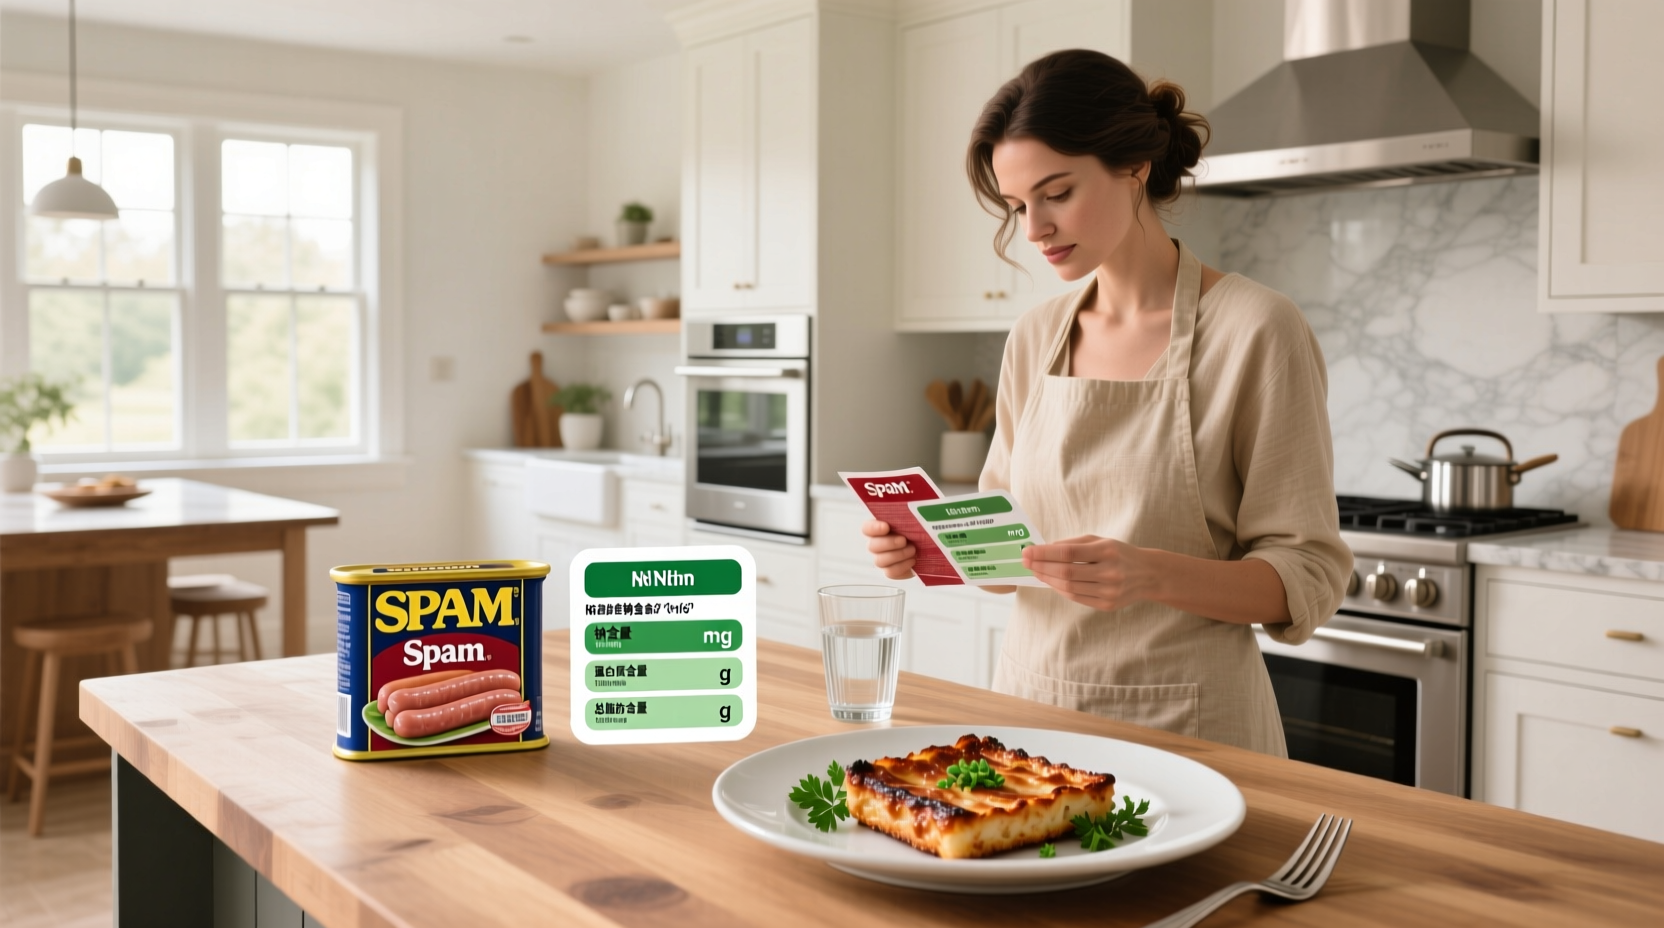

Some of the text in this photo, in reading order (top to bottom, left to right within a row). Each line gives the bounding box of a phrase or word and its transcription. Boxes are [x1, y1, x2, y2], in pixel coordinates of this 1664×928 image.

[375, 587, 515, 633] SPAM
[703, 630, 732, 649] mg
[403, 640, 485, 670] Spam
[719, 668, 731, 686] g
[719, 705, 731, 723] g
